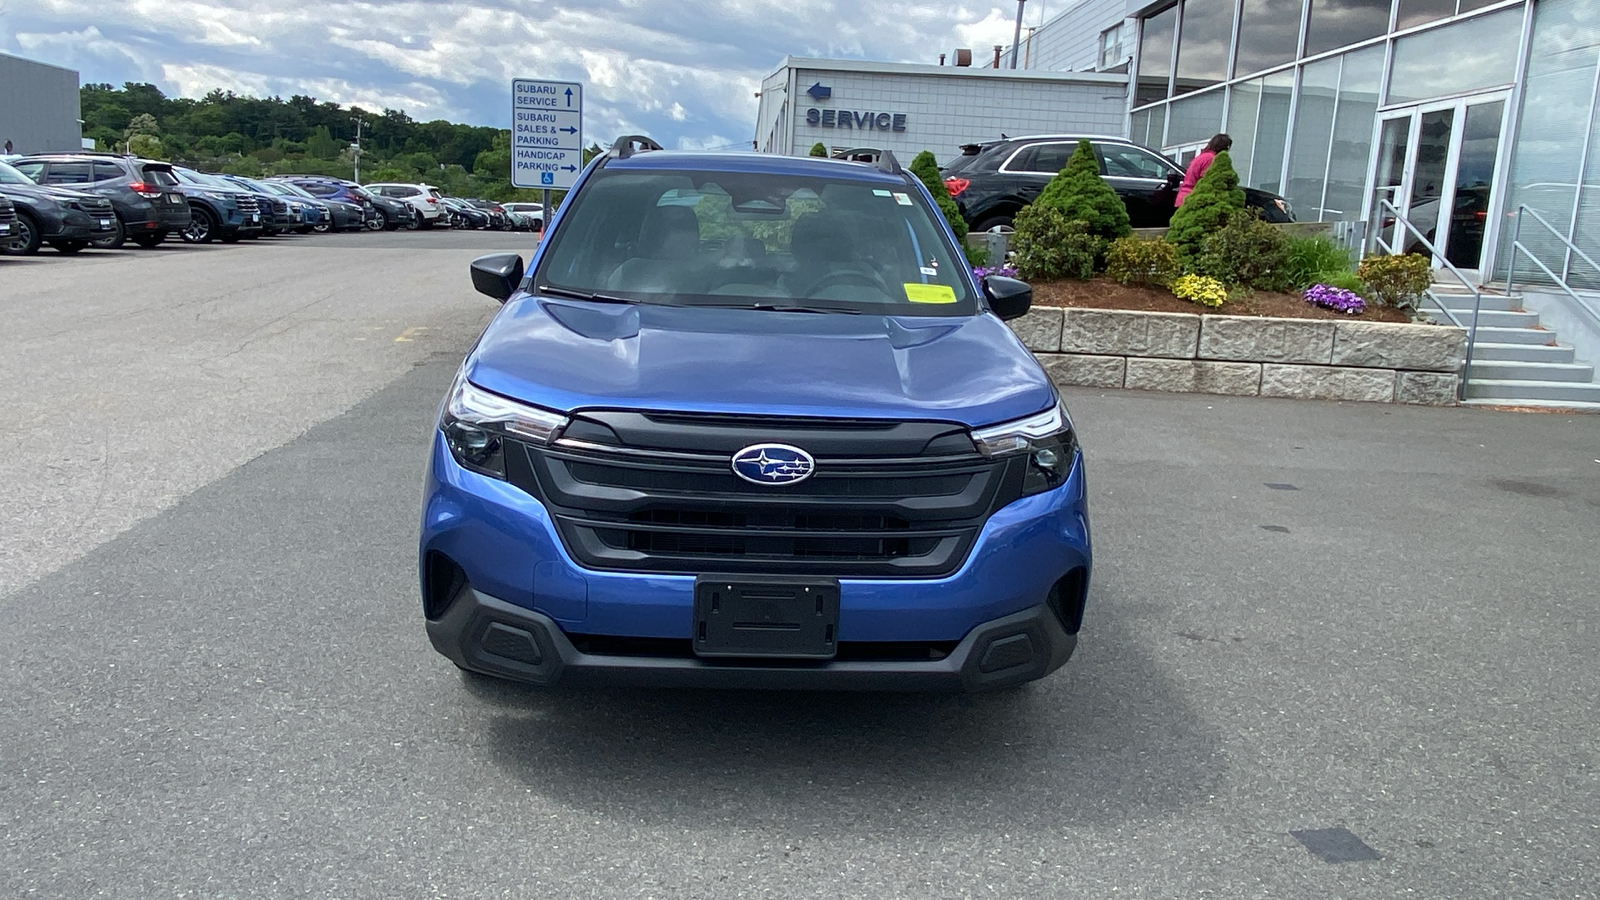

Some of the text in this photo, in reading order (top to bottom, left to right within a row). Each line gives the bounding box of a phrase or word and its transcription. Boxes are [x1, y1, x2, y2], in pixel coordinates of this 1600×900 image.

[517, 84, 556, 94] SUBARU
[517, 96, 557, 106] SERVICE
[517, 112, 556, 122] SUBARU
[806, 108, 907, 132] SERVICE
[517, 124, 556, 134] SALES &
[517, 136, 559, 146] PARKING
[517, 150, 565, 160] HANDICAP
[517, 161, 559, 171] PARKING
